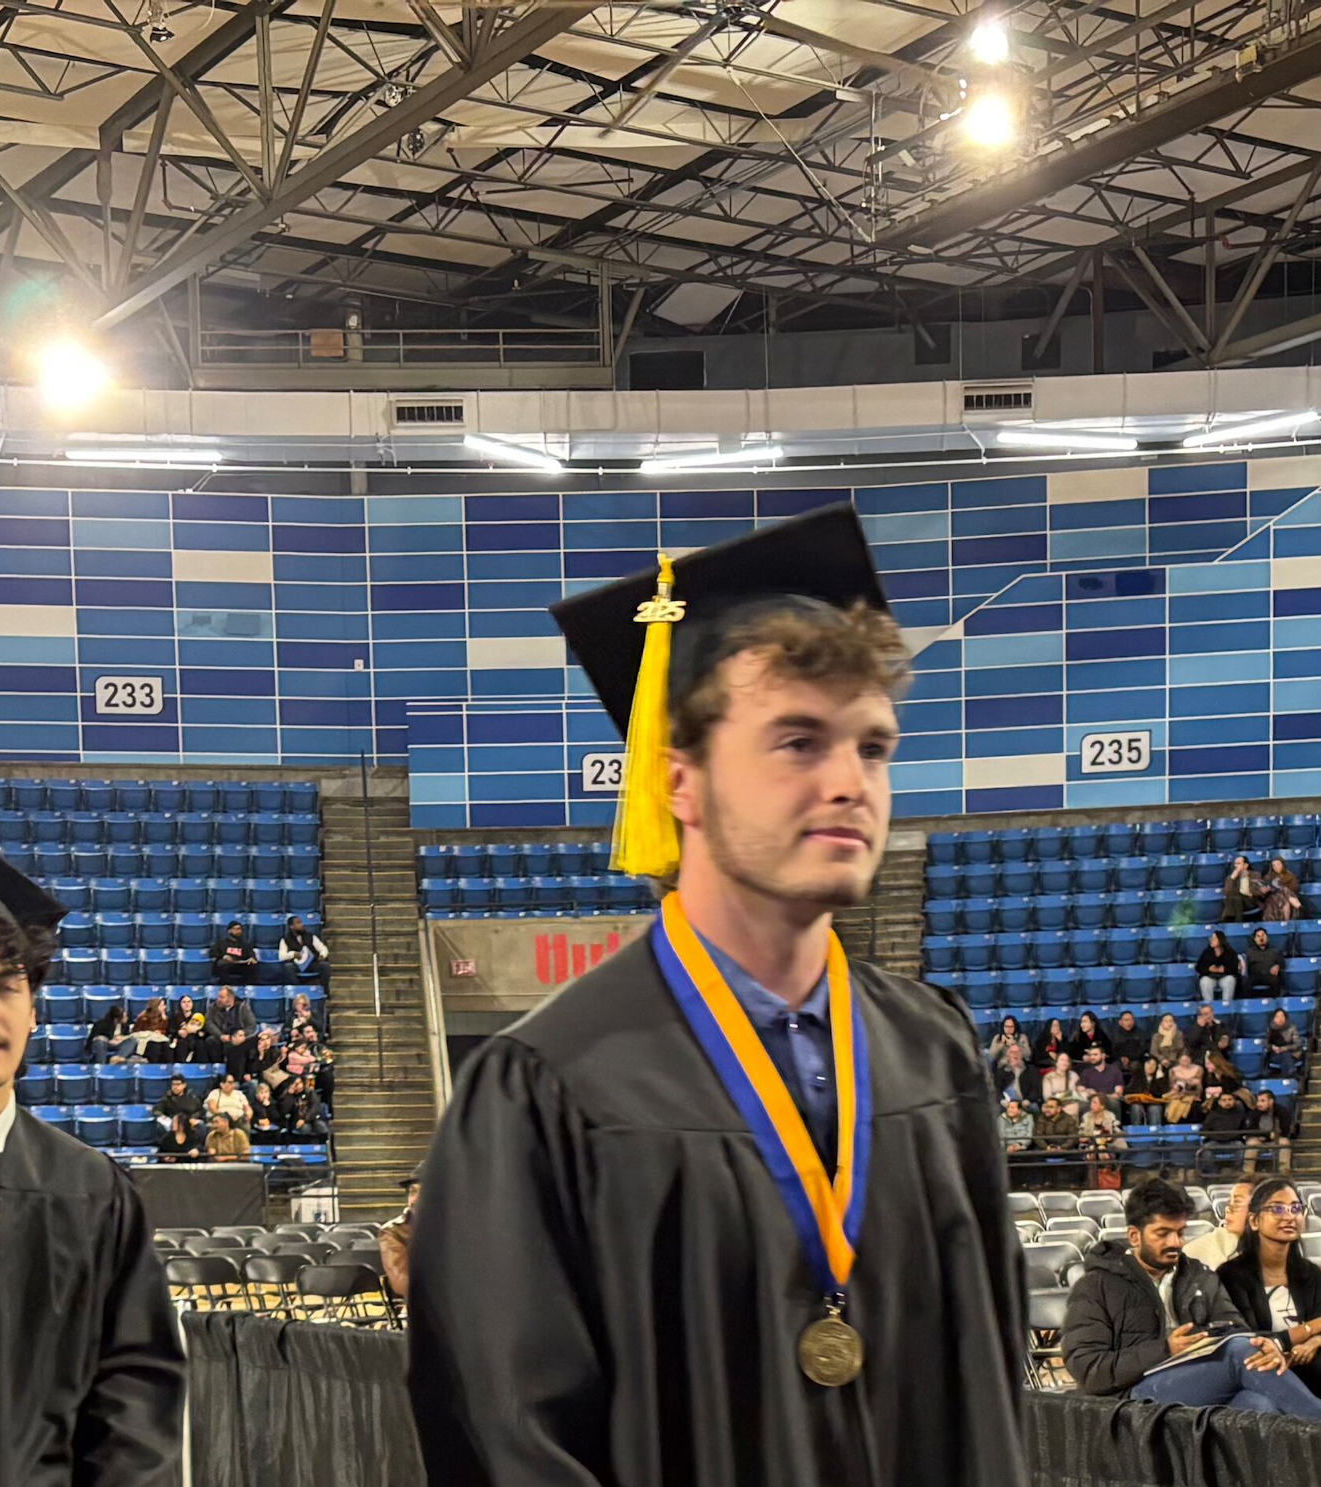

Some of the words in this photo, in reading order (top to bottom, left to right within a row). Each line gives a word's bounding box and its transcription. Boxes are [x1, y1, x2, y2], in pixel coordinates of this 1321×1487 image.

[103, 682, 155, 708] 233
[1090, 738, 1142, 766] 235
[590, 759, 622, 785] 23
